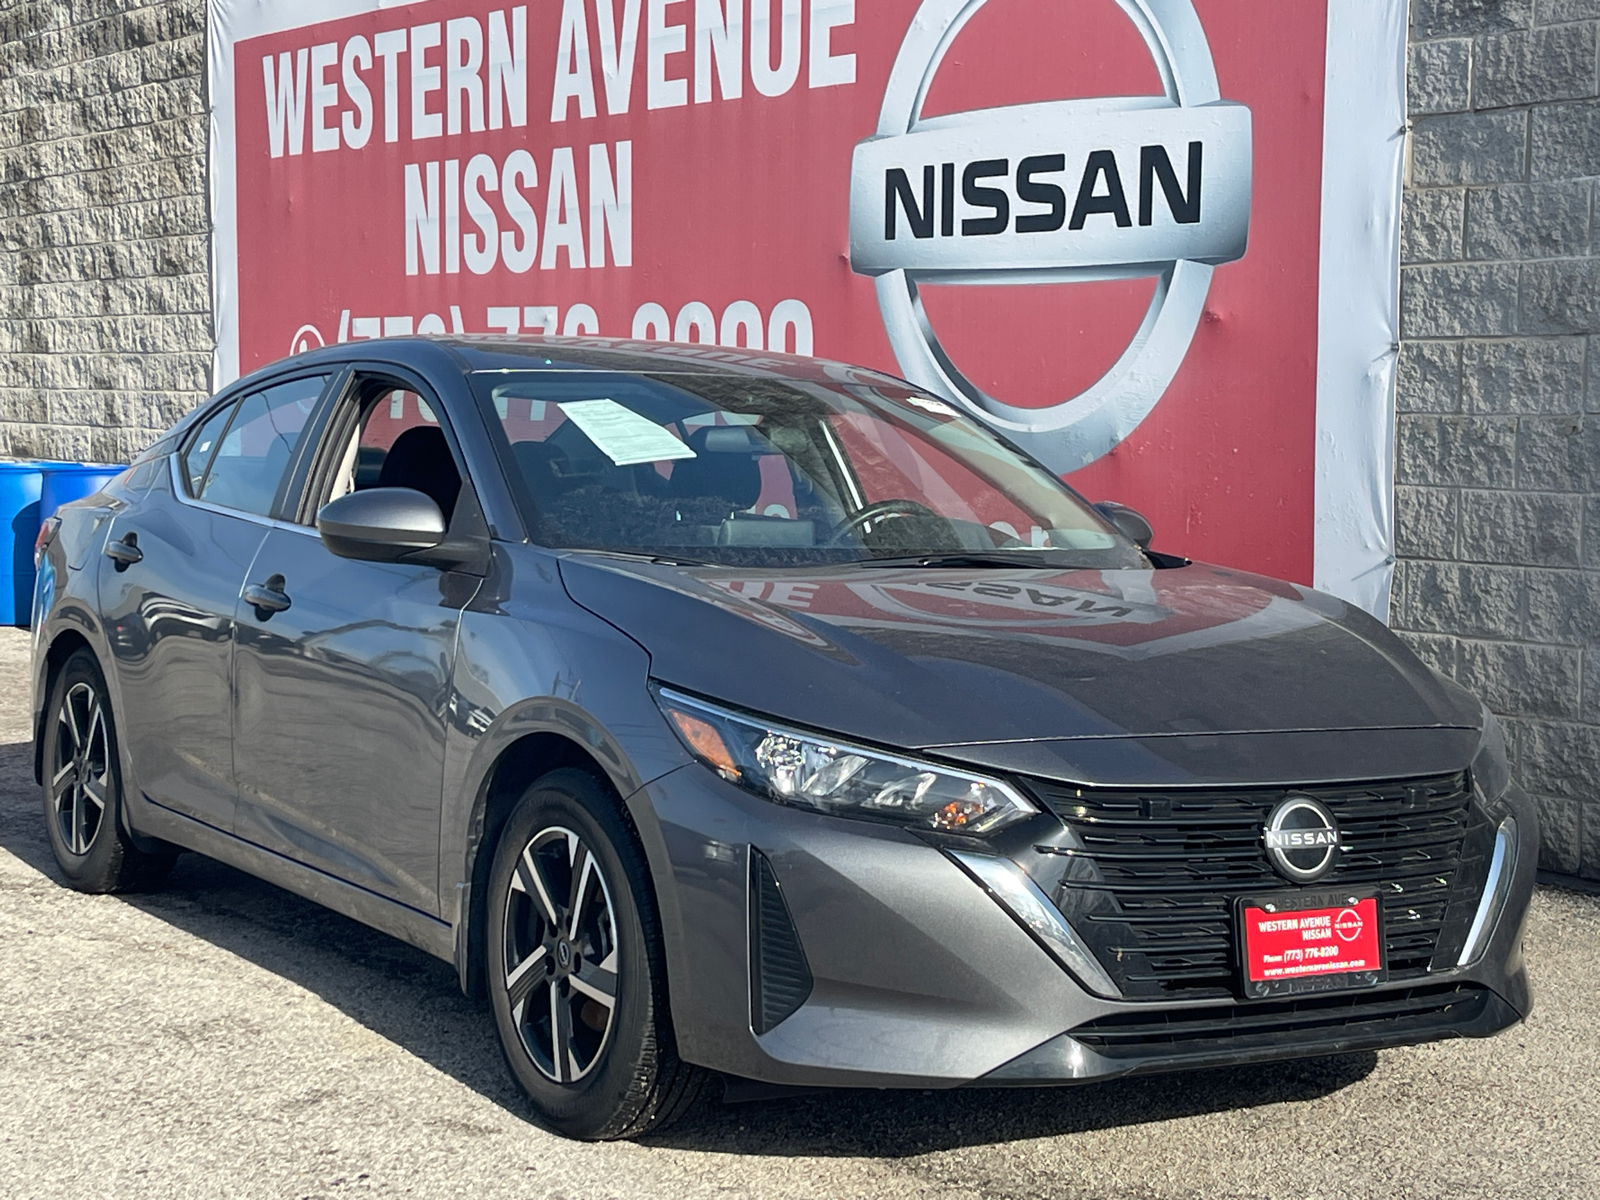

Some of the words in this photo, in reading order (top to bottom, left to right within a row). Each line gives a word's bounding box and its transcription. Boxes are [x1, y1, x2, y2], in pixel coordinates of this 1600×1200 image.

[262, 5, 528, 159] WESTERN
[550, 0, 857, 123] AVENUE
[885, 141, 1203, 241] NISSAN
[404, 140, 633, 276] NISSAN
[1268, 830, 1338, 846] NISSAN
[1258, 918, 1299, 933] WESTERN
[1299, 916, 1331, 929] AVENUE
[1334, 921, 1363, 929] NISSAN
[1302, 928, 1332, 941] NISSAN
[1283, 949, 1303, 963] (773)
[1304, 946, 1339, 959] 776-8200
